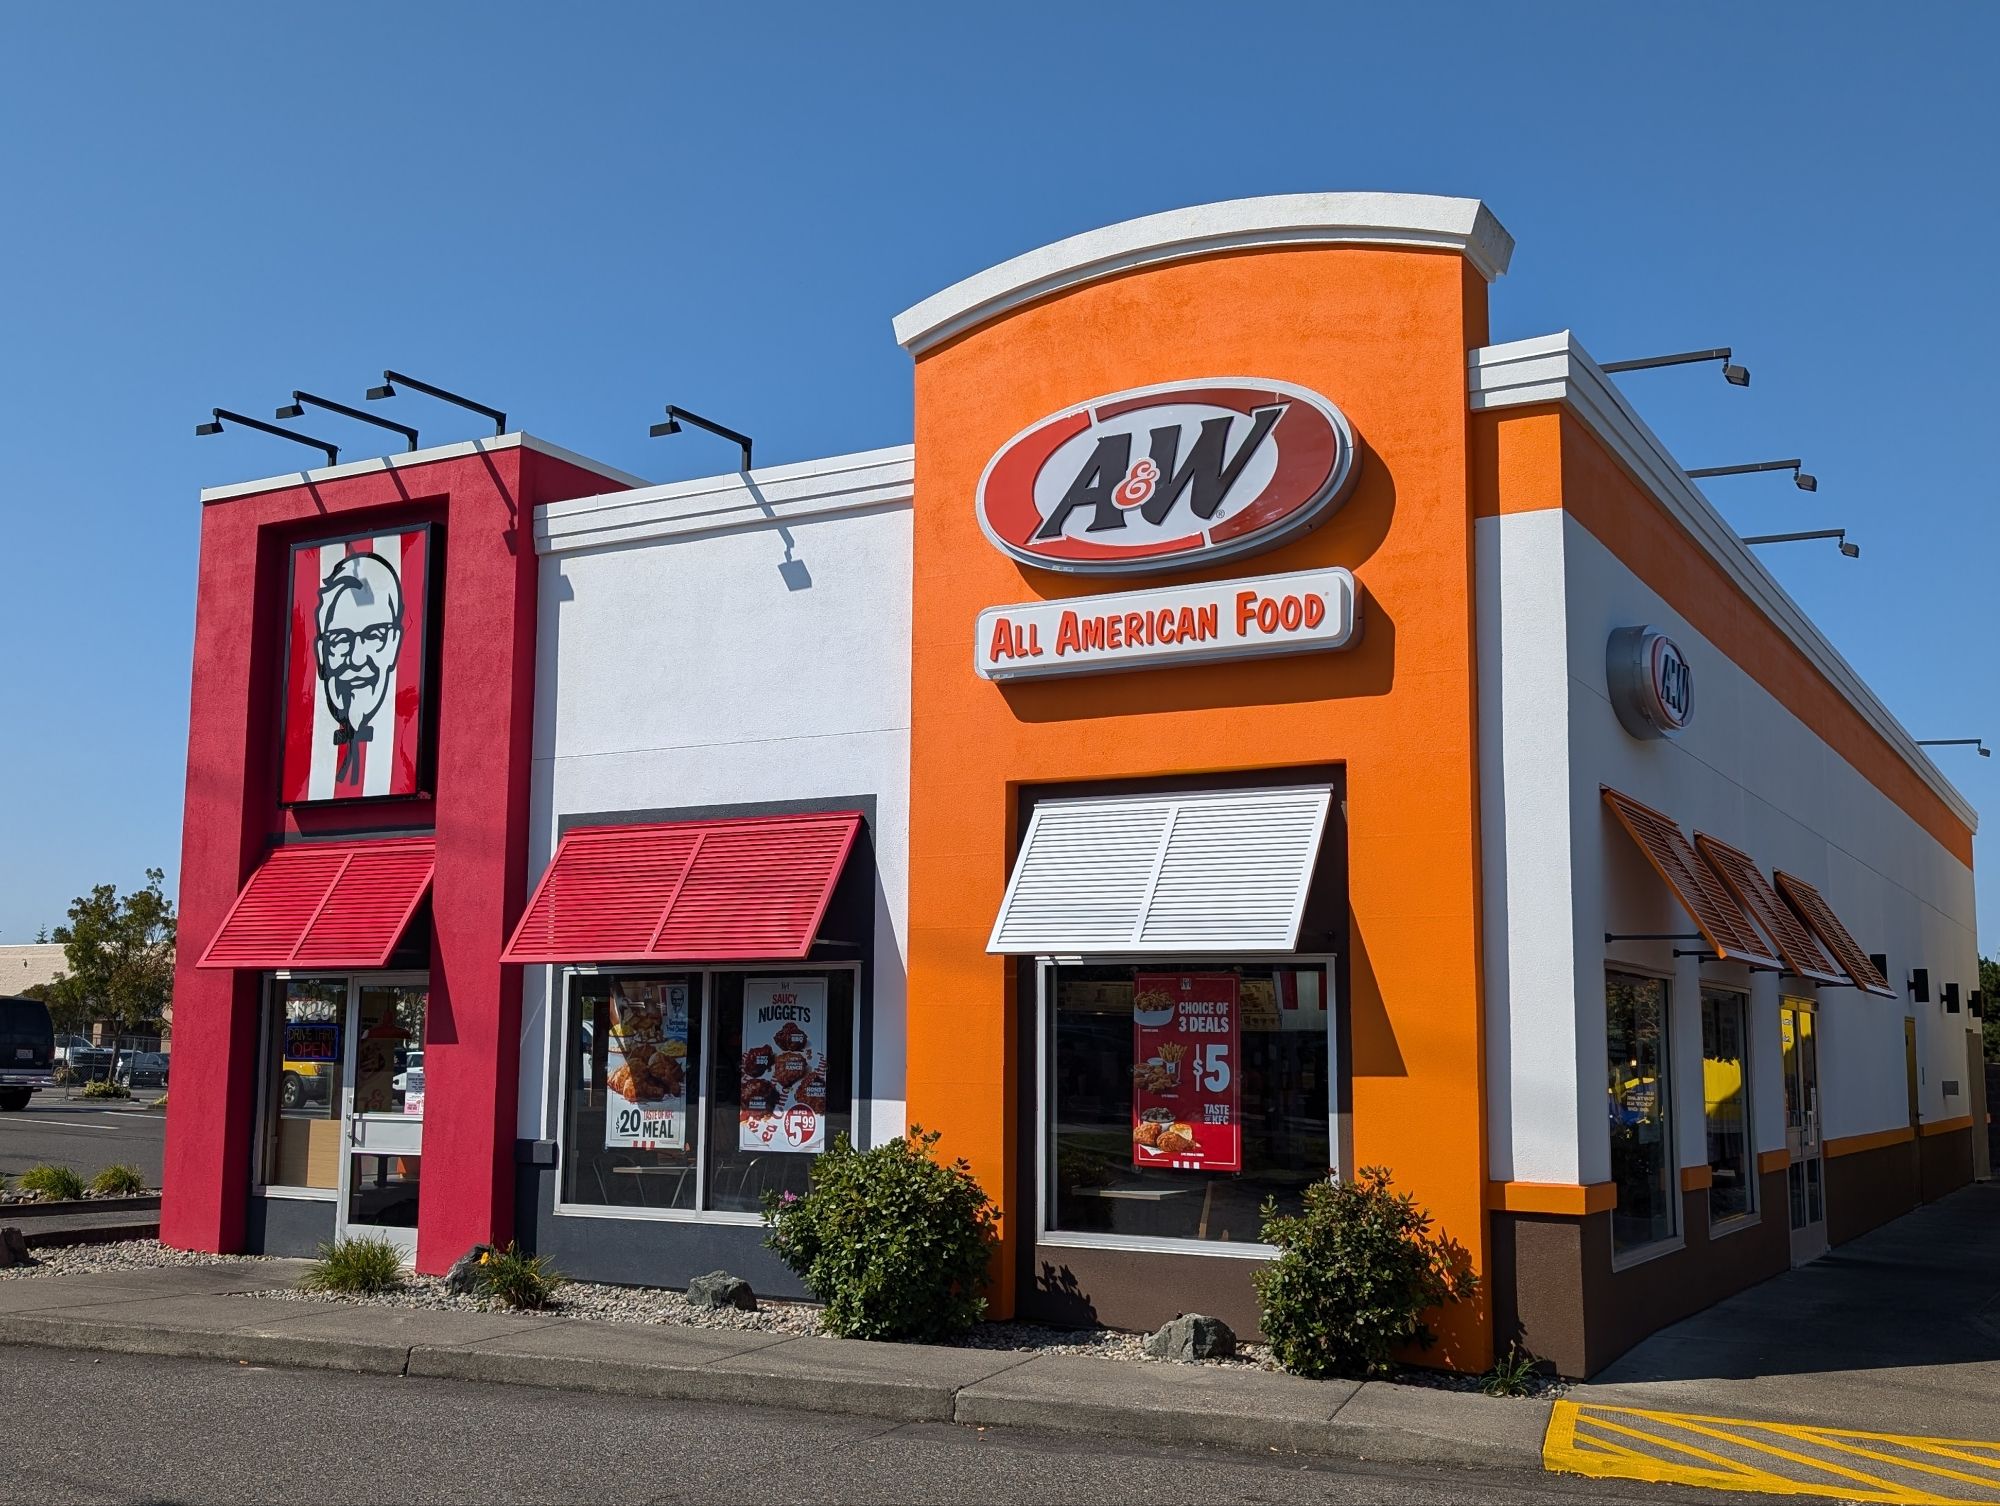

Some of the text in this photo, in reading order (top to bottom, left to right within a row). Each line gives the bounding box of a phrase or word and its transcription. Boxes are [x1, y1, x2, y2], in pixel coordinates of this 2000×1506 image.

[1034, 406, 1284, 540] A&W
[772, 993, 798, 1005] SAUCY
[758, 1005, 811, 1023] NUGGETS
[1178, 1001, 1229, 1015] CHOICE OF
[1178, 1016, 1230, 1033] 3 DEALS
[293, 1042, 332, 1057] OPEN
[1192, 1043, 1231, 1093] $5
[1204, 1104, 1230, 1116] TASTE
[615, 1109, 641, 1134] $20
[642, 1119, 675, 1138] MEAL
[1212, 1115, 1229, 1125] KFC
